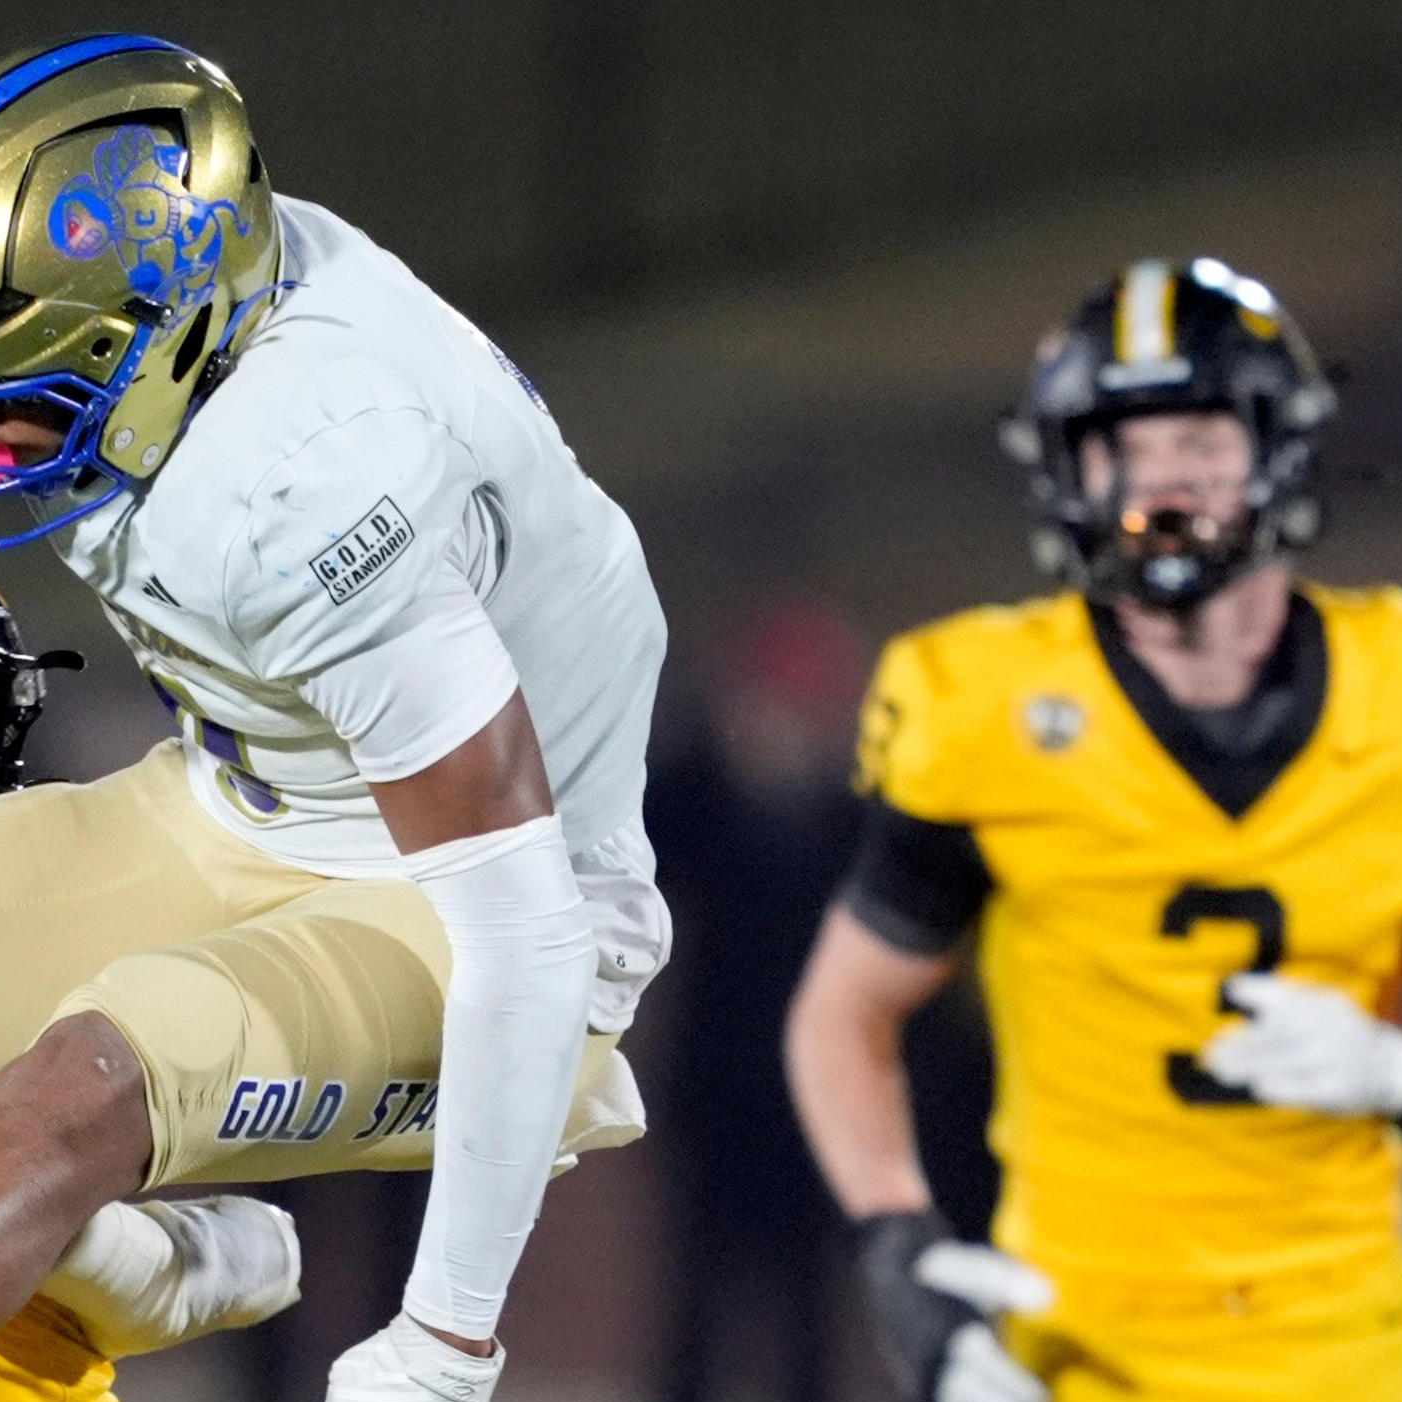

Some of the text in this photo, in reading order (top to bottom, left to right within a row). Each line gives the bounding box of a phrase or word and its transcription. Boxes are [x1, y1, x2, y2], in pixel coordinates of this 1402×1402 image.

[318, 514, 399, 581] G.O.L.D.
[333, 527, 407, 597] STANDARD
[216, 1078, 440, 1143] GOLD STA
